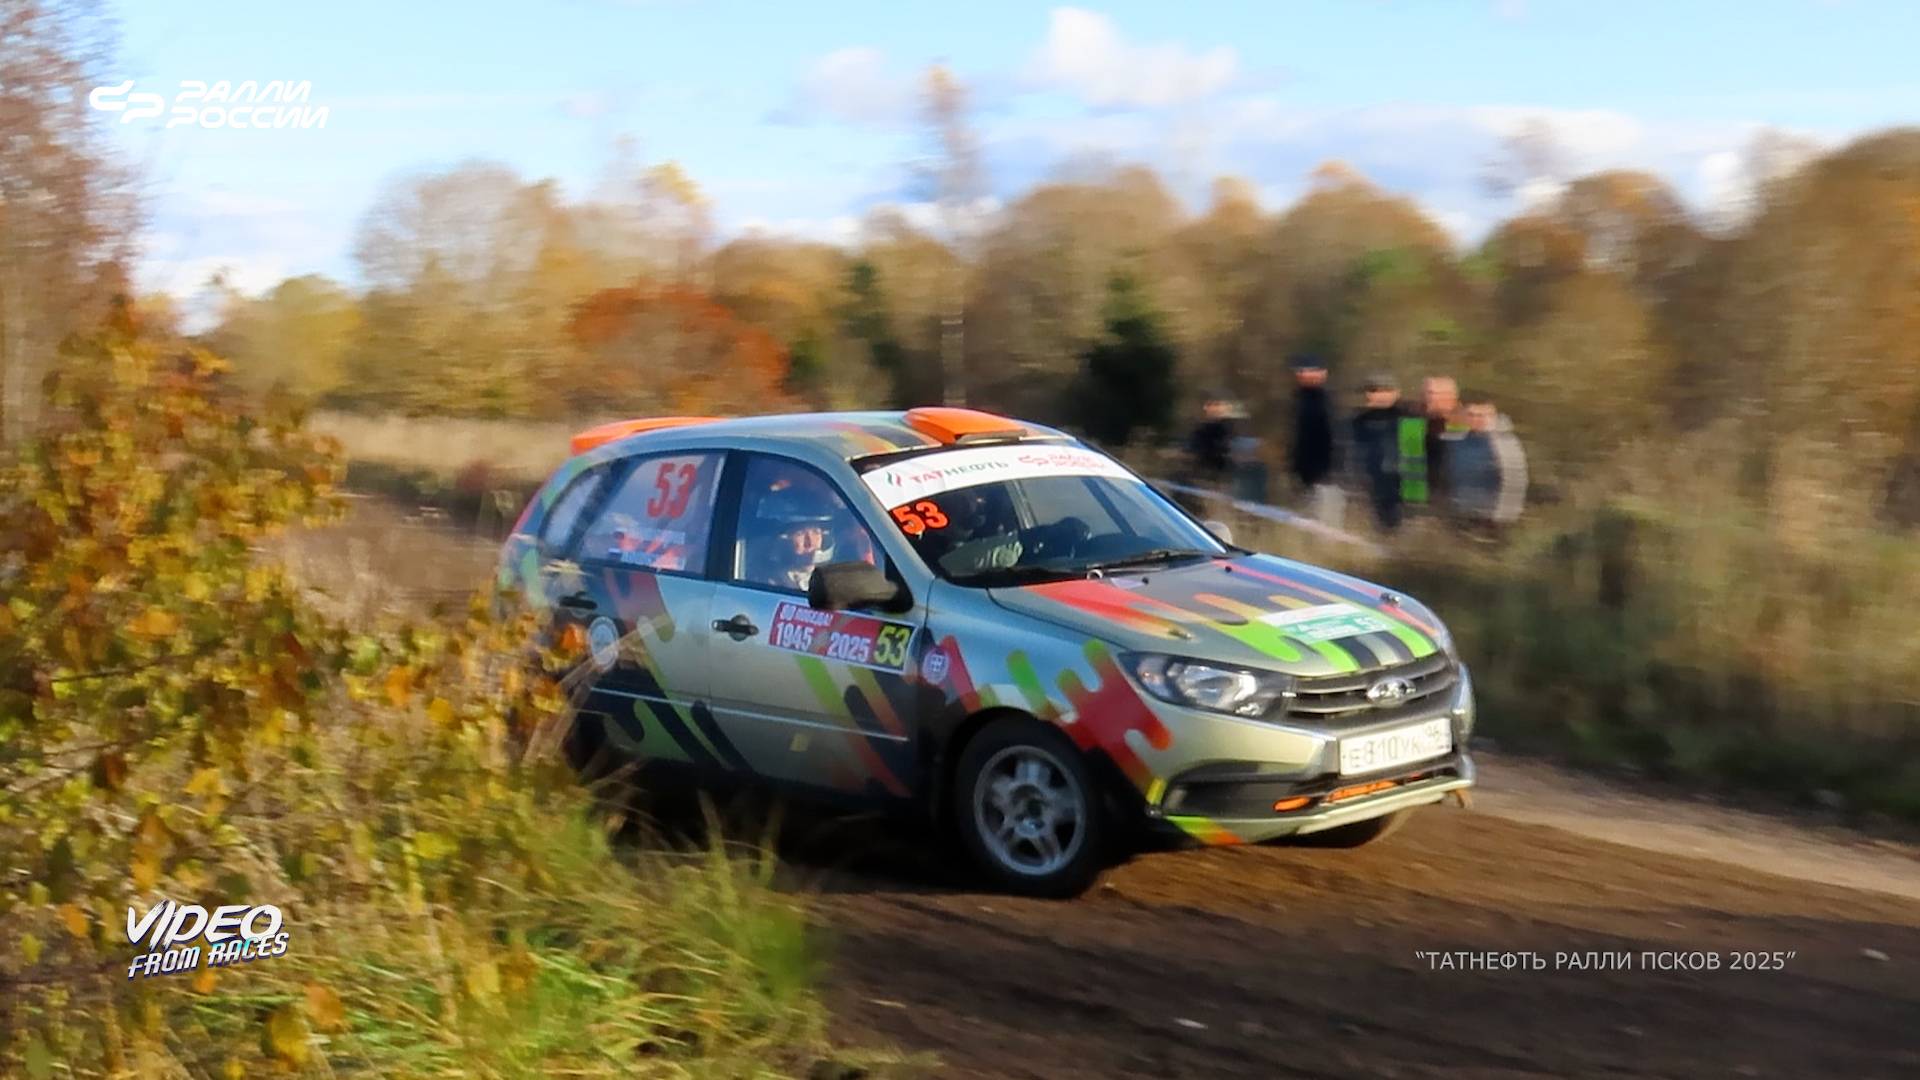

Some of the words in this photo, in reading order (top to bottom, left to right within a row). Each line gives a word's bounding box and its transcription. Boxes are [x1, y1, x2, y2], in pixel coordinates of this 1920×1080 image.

[647, 462, 697, 518] 53
[909, 461, 1010, 484] ТАТНЕФТЬ
[892, 501, 948, 535] 53
[776, 622, 814, 653] 1945
[826, 631, 871, 663] 2025
[873, 625, 911, 667] 53
